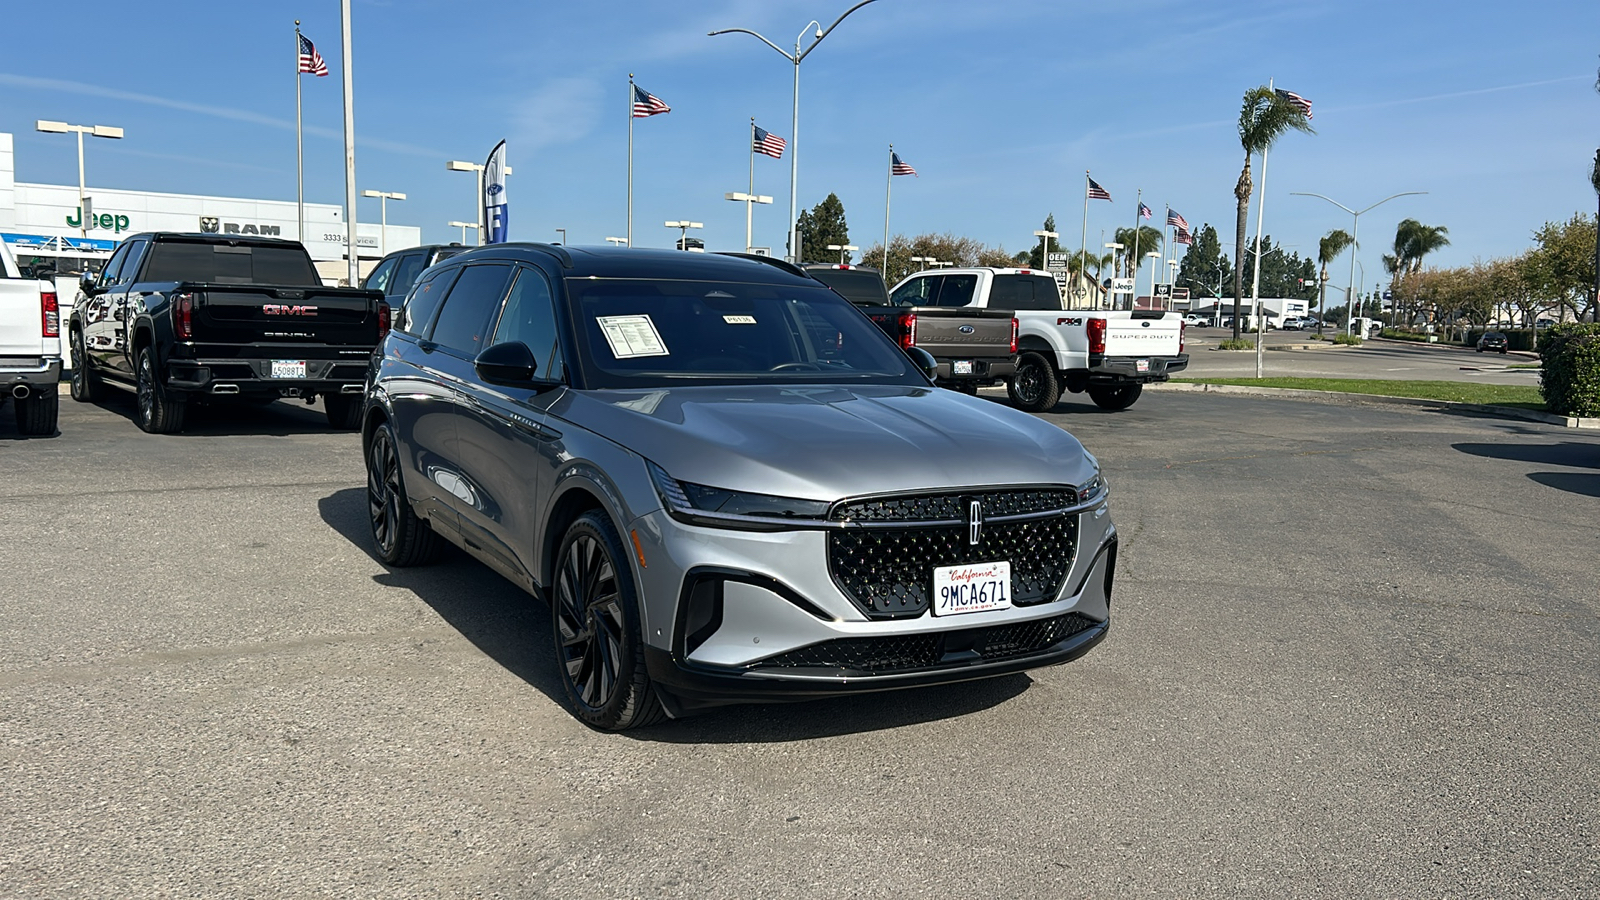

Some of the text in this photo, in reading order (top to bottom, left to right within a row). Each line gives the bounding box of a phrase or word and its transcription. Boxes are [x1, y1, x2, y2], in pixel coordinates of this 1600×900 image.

[224, 223, 280, 236] RAM
[323, 234, 341, 242] 3333
[342, 236, 374, 244] Svice
[1049, 253, 1067, 261] OEM
[1115, 283, 1133, 291] Jeep
[263, 304, 318, 316] GMC
[1057, 318, 1082, 327] FX4
[950, 568, 997, 583] California
[941, 580, 1006, 608] 9MCA671
[954, 604, 993, 612] dmv.ca.gov
